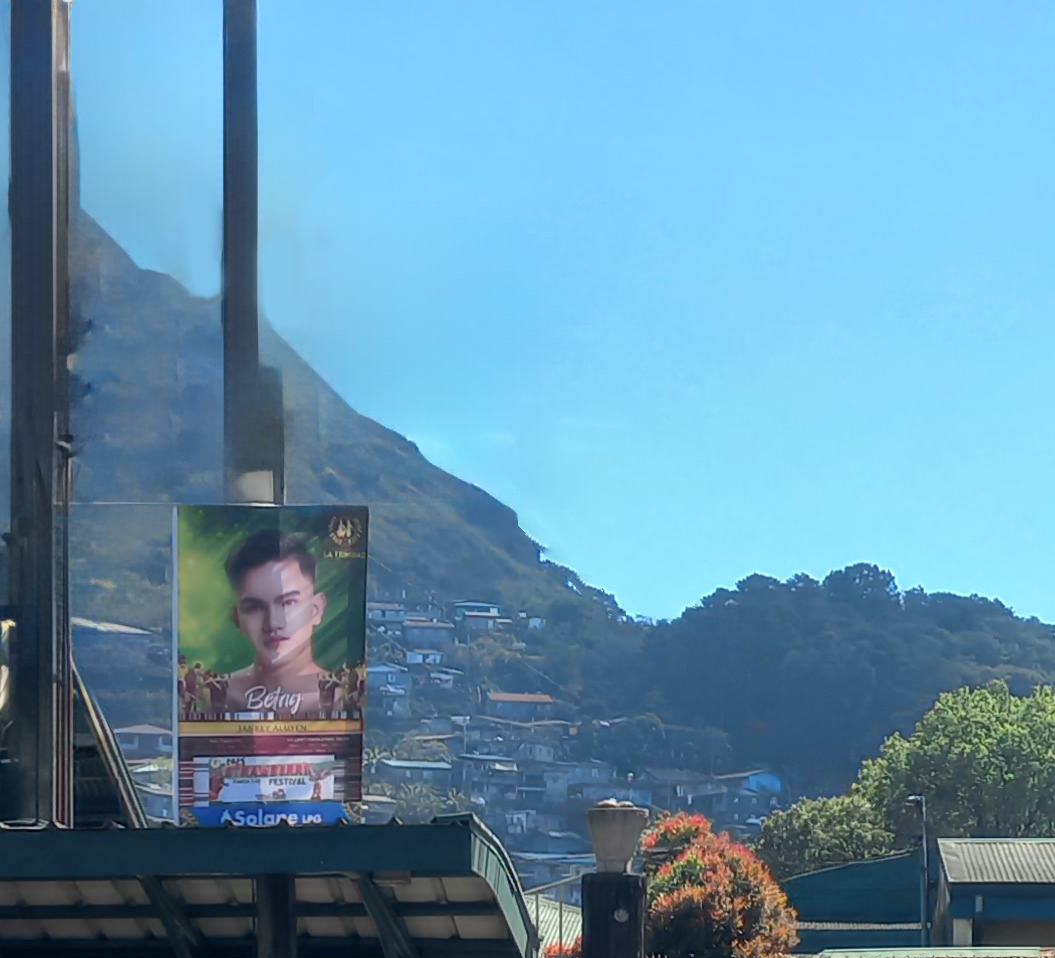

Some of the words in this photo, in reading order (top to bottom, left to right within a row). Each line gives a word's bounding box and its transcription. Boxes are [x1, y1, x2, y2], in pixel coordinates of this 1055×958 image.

[268, 777, 307, 786] FESTIVAL
[234, 808, 299, 827] Solane
[302, 813, 322, 824] LPG
